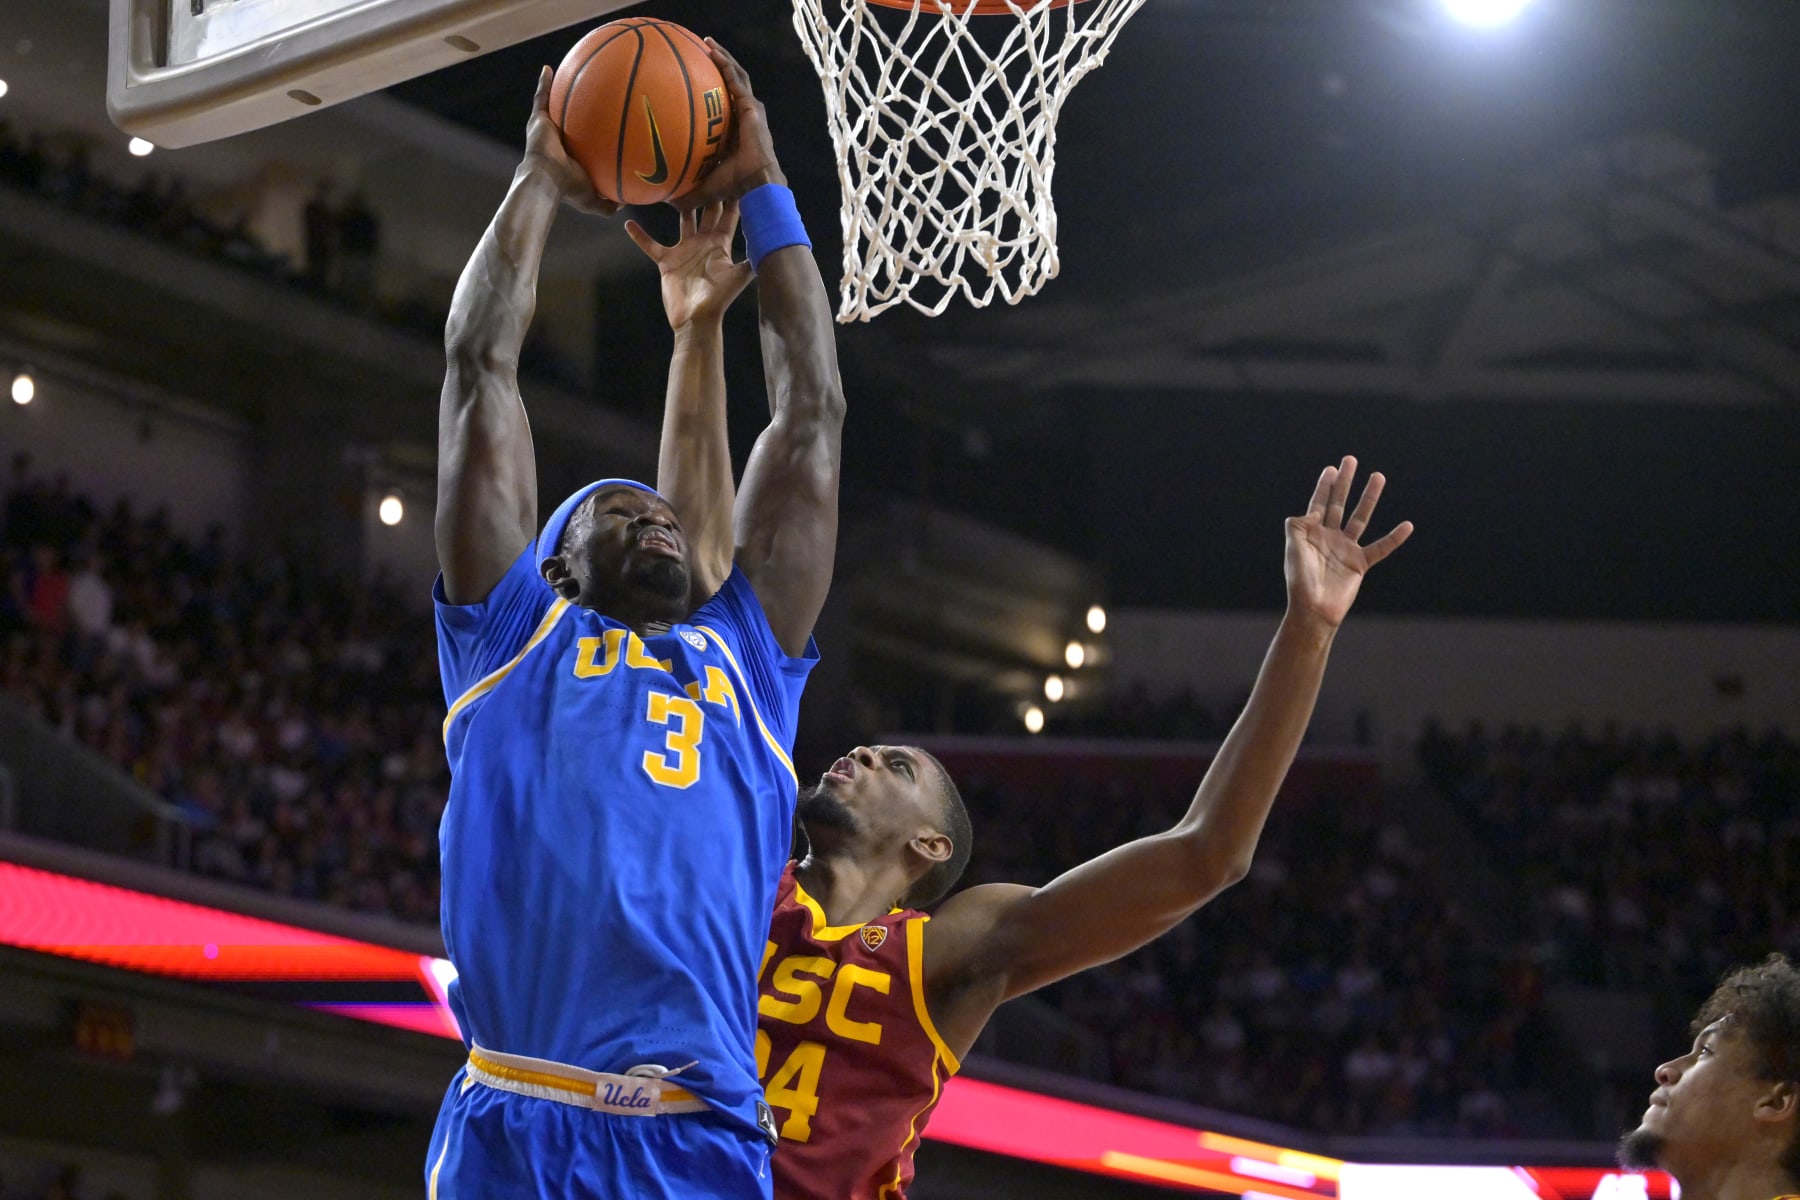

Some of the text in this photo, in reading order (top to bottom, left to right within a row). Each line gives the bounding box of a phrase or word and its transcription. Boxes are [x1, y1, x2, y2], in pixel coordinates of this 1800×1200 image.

[573, 628, 741, 728] UCA
[643, 692, 704, 789] 3
[867, 935, 880, 945] 12
[604, 1083, 651, 1109] Ucla
